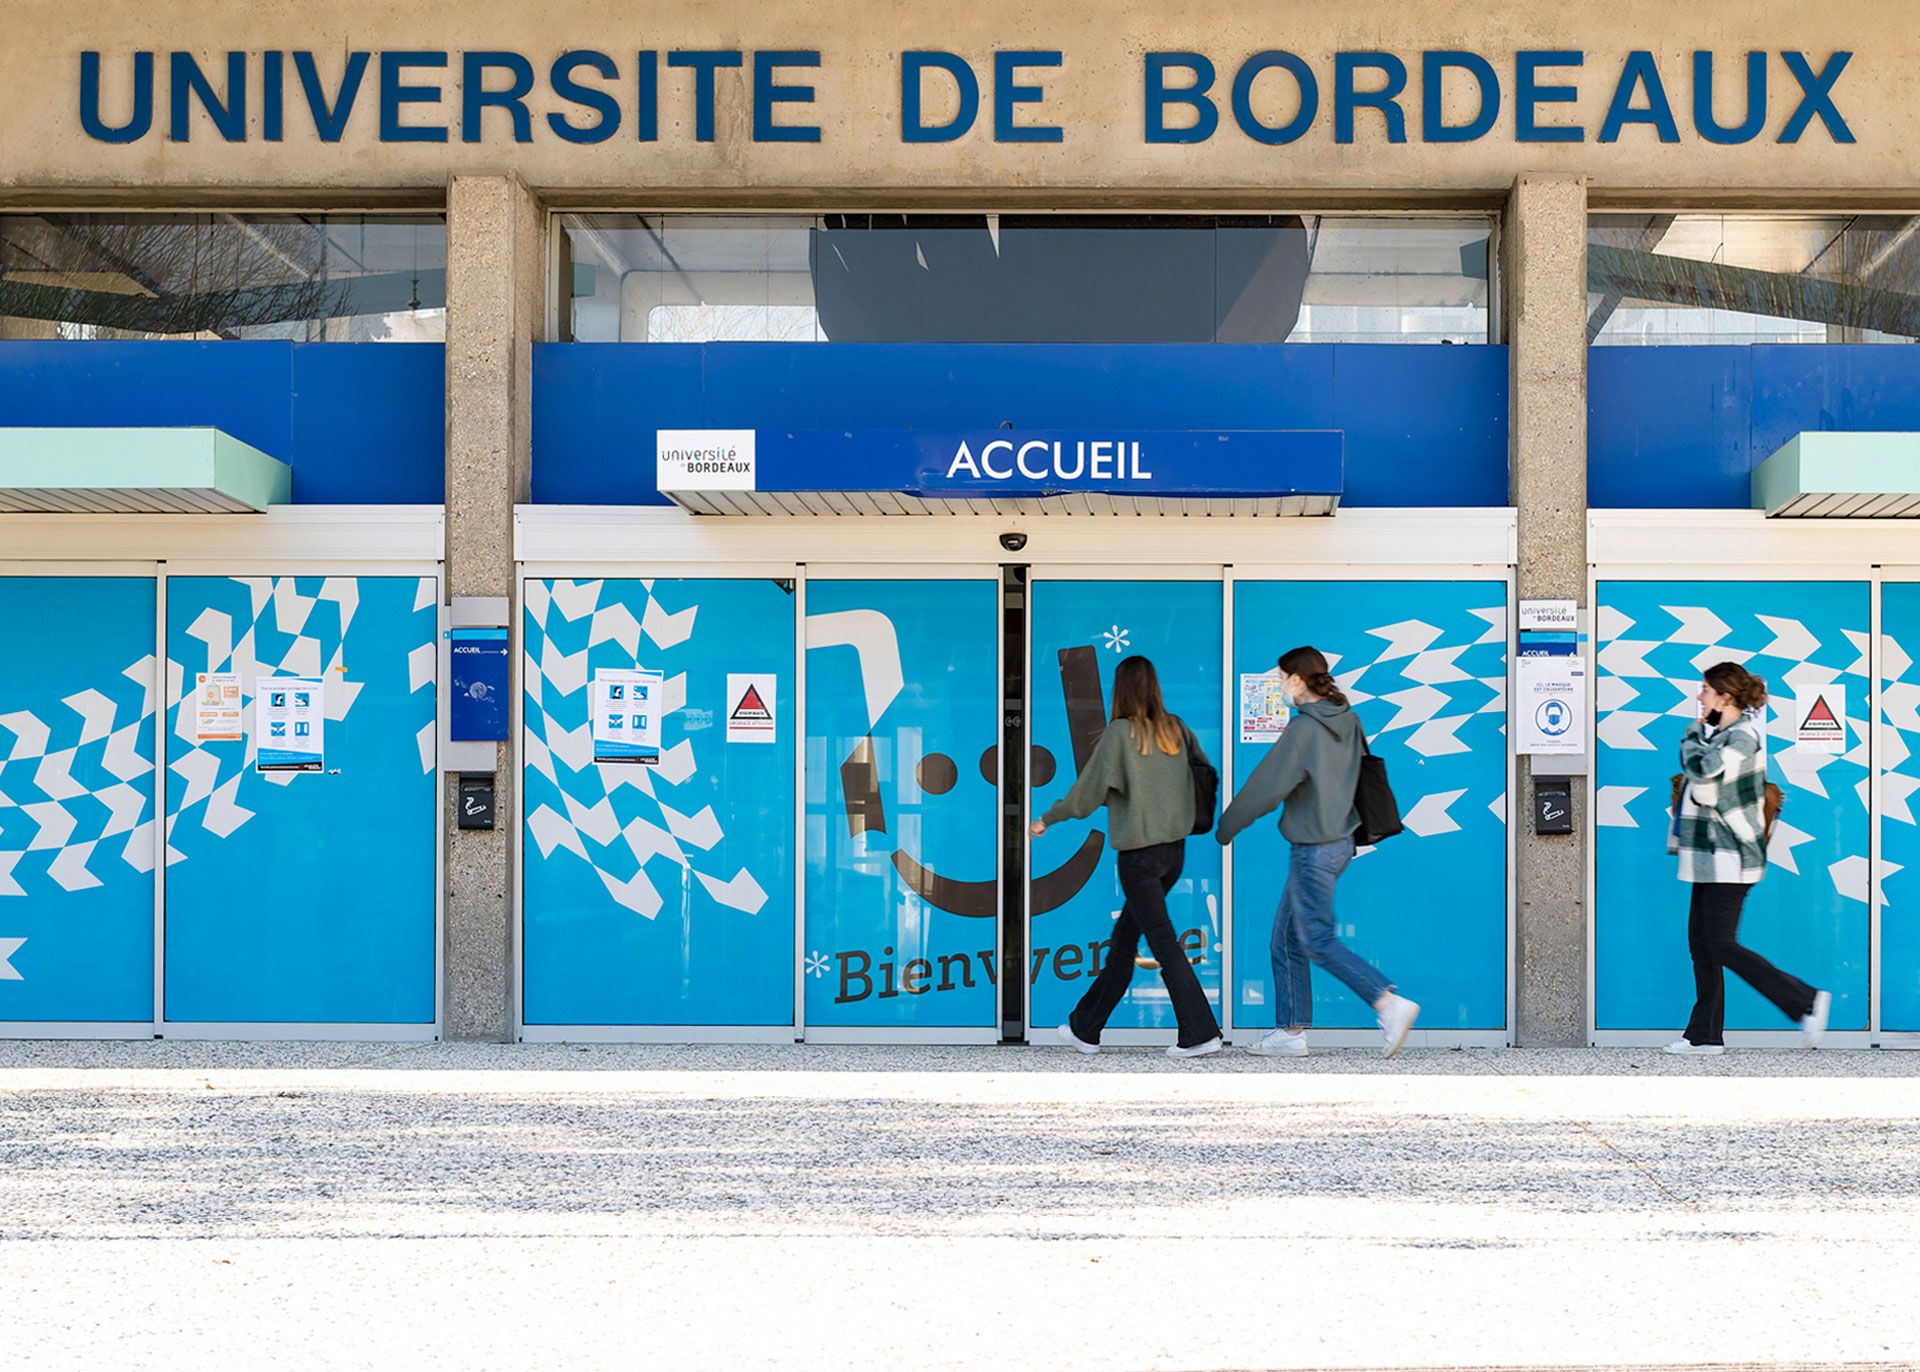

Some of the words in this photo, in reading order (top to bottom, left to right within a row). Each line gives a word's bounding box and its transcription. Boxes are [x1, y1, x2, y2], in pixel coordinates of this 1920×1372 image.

[79, 50, 821, 144] UNIVERSITE
[903, 50, 1063, 143] DE
[1145, 50, 1857, 145] BORDEAUX
[662, 445, 736, 462] université
[946, 440, 1152, 480] ACCUEIL
[687, 462, 751, 474] BORDEAUX
[1537, 614, 1575, 622] BORDEAUX
[453, 646, 481, 654] ACCUEIL
